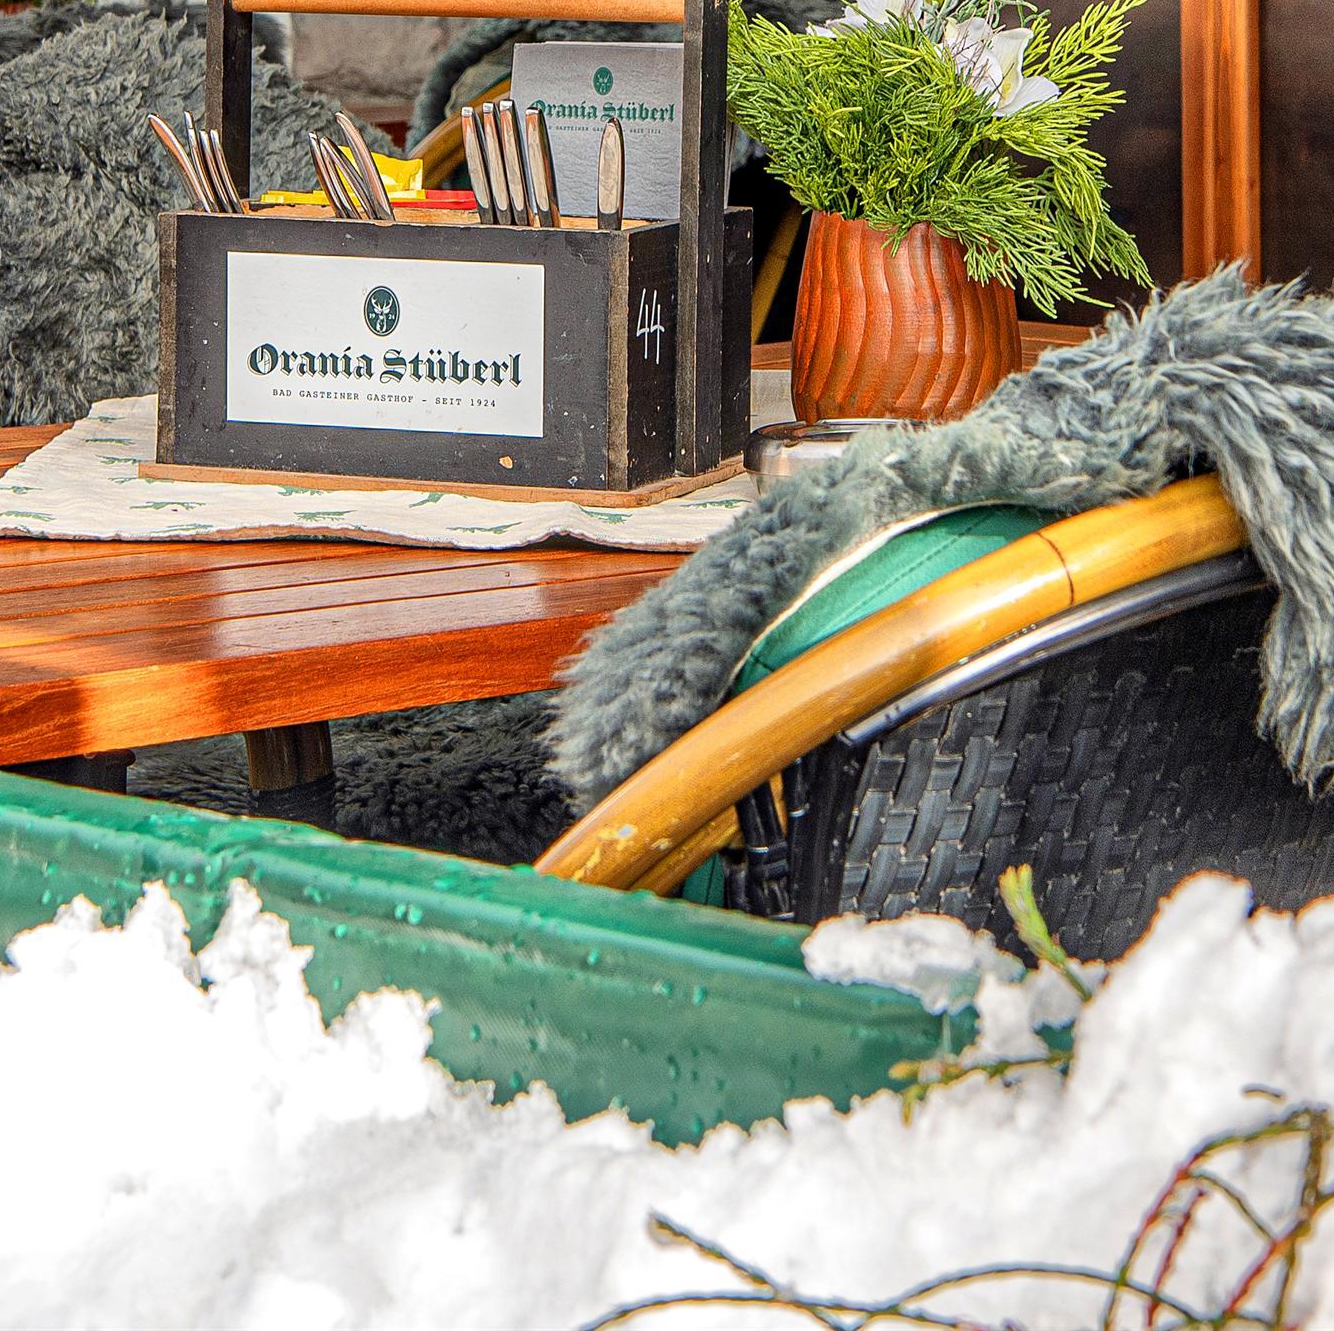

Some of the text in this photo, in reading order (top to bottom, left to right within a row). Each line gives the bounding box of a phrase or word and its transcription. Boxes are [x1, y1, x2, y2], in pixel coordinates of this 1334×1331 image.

[600, 102, 675, 122] Stüberl
[246, 342, 523, 388] Orania Stüberl
[272, 389, 292, 398] BAD
[299, 390, 360, 401] GASTEINER
[366, 393, 414, 404] GASTHOF
[434, 397, 462, 406] SEIT
[470, 399, 497, 408] 1924
